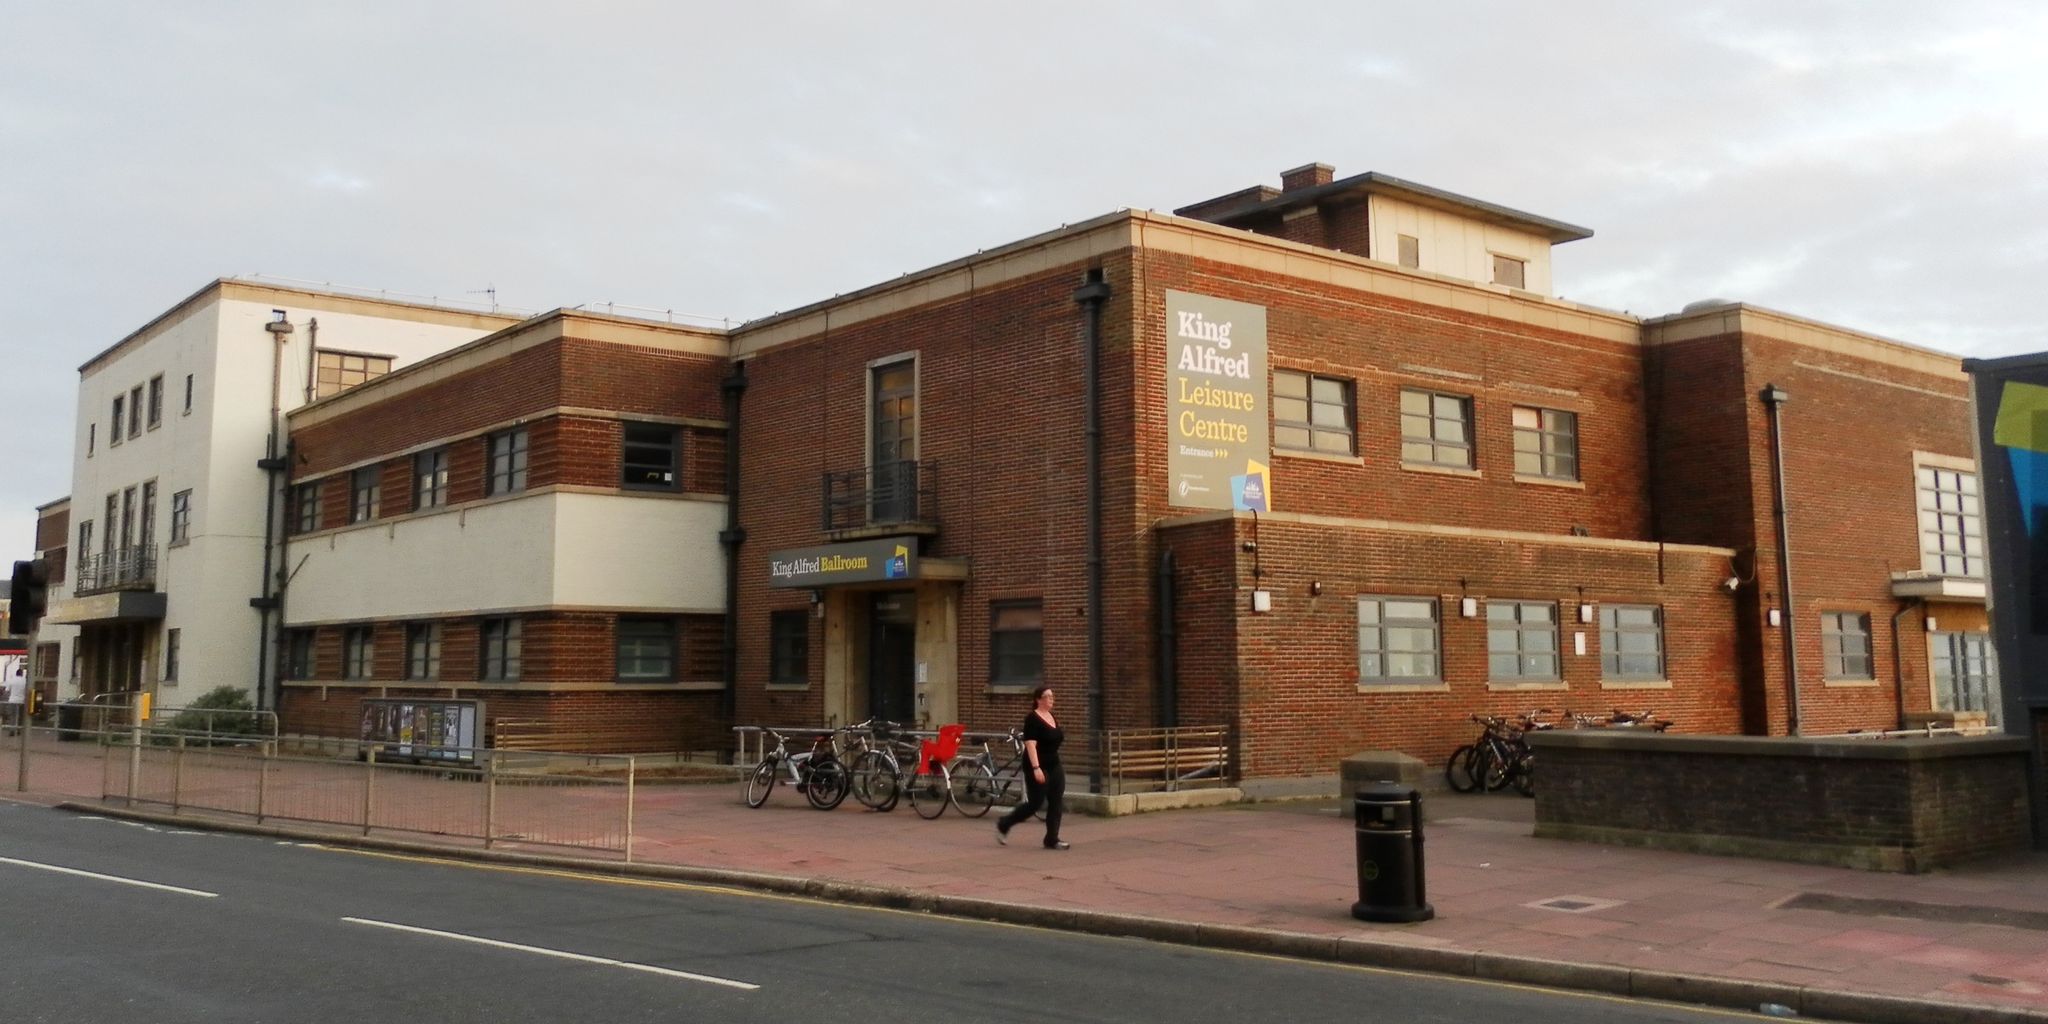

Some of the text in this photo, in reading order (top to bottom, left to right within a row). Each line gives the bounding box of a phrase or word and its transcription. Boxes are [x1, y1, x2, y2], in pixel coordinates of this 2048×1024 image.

[1178, 311, 1232, 349] King
[1178, 345, 1250, 379] Alfred
[1179, 377, 1254, 411] Leisure
[1180, 410, 1248, 443] Centre
[1180, 445, 1214, 458] Entrance
[772, 555, 868, 578] King Alfred Ballroom
